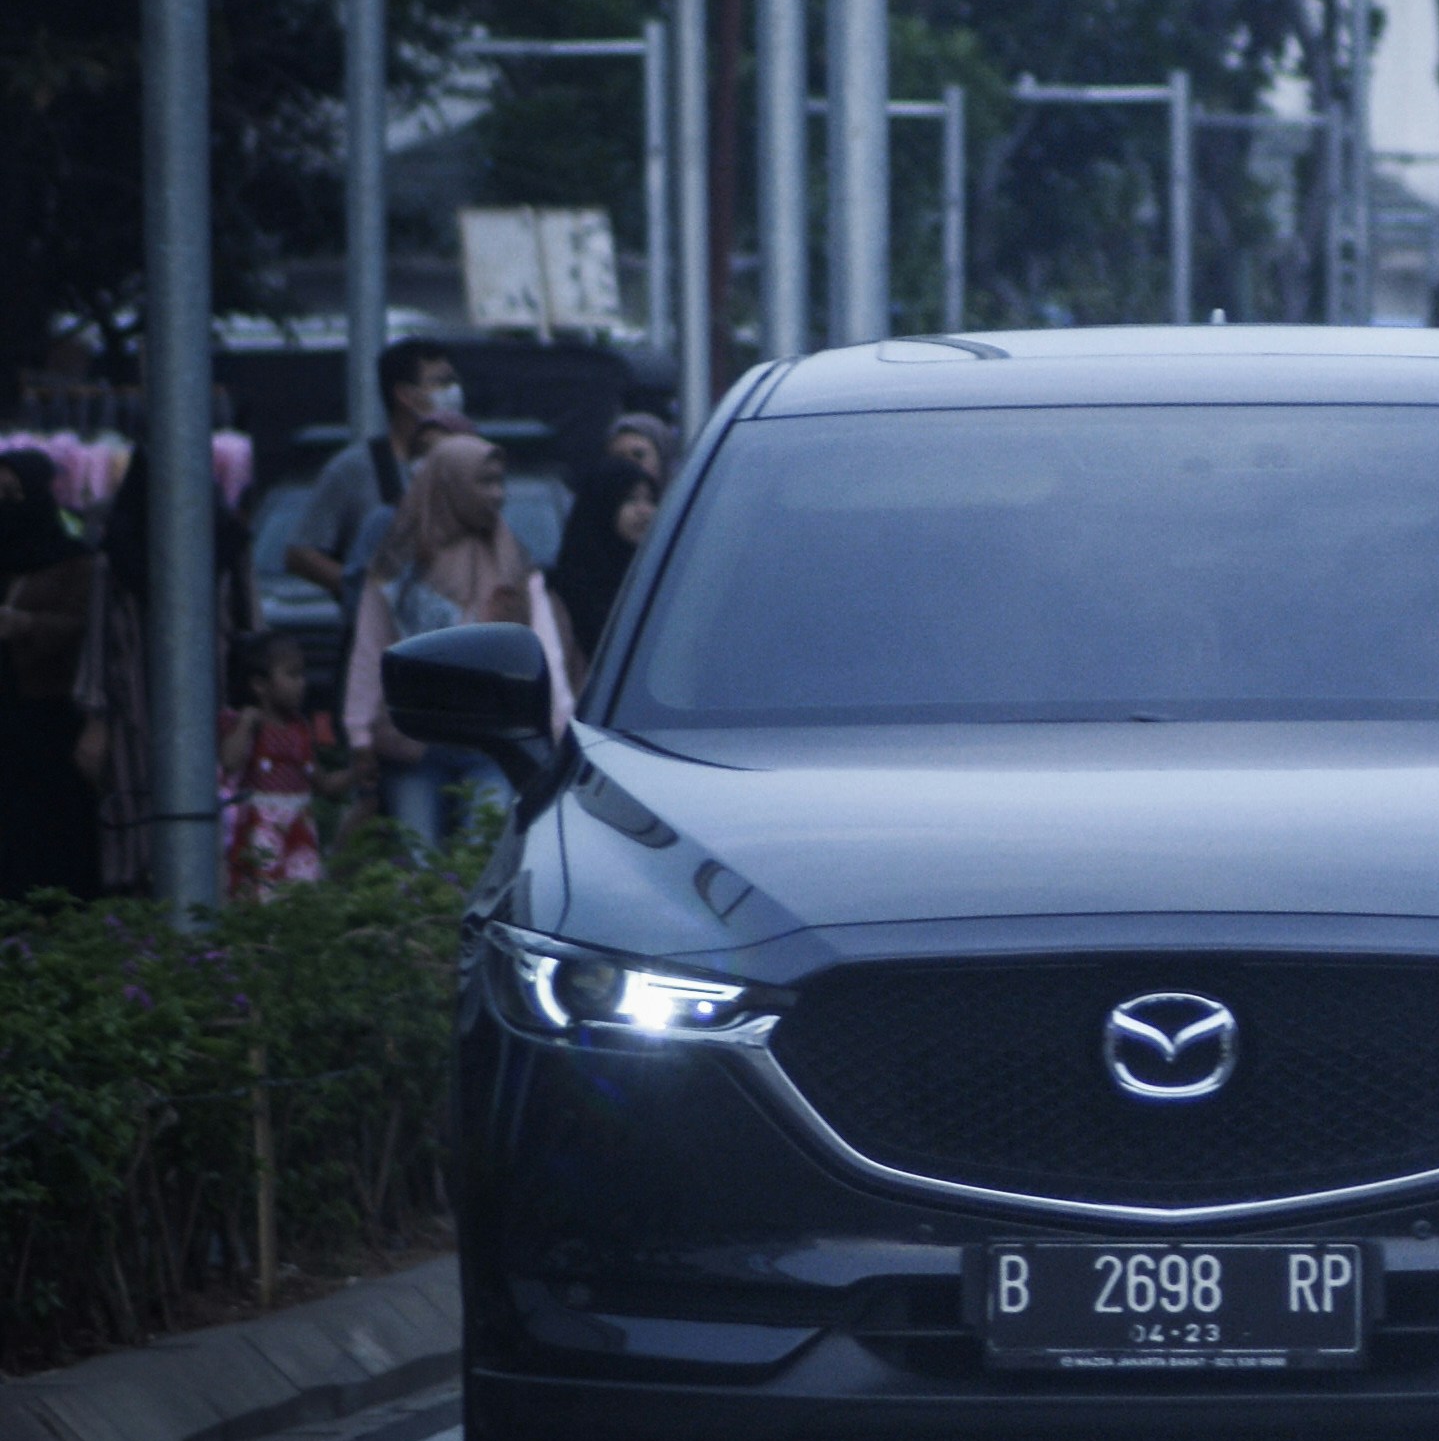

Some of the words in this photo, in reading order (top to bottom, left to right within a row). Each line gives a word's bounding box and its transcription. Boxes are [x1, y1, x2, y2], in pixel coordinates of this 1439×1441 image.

[998, 1254, 1030, 1313] B
[1094, 1254, 1222, 1313] 2698
[1288, 1254, 1352, 1313] RP
